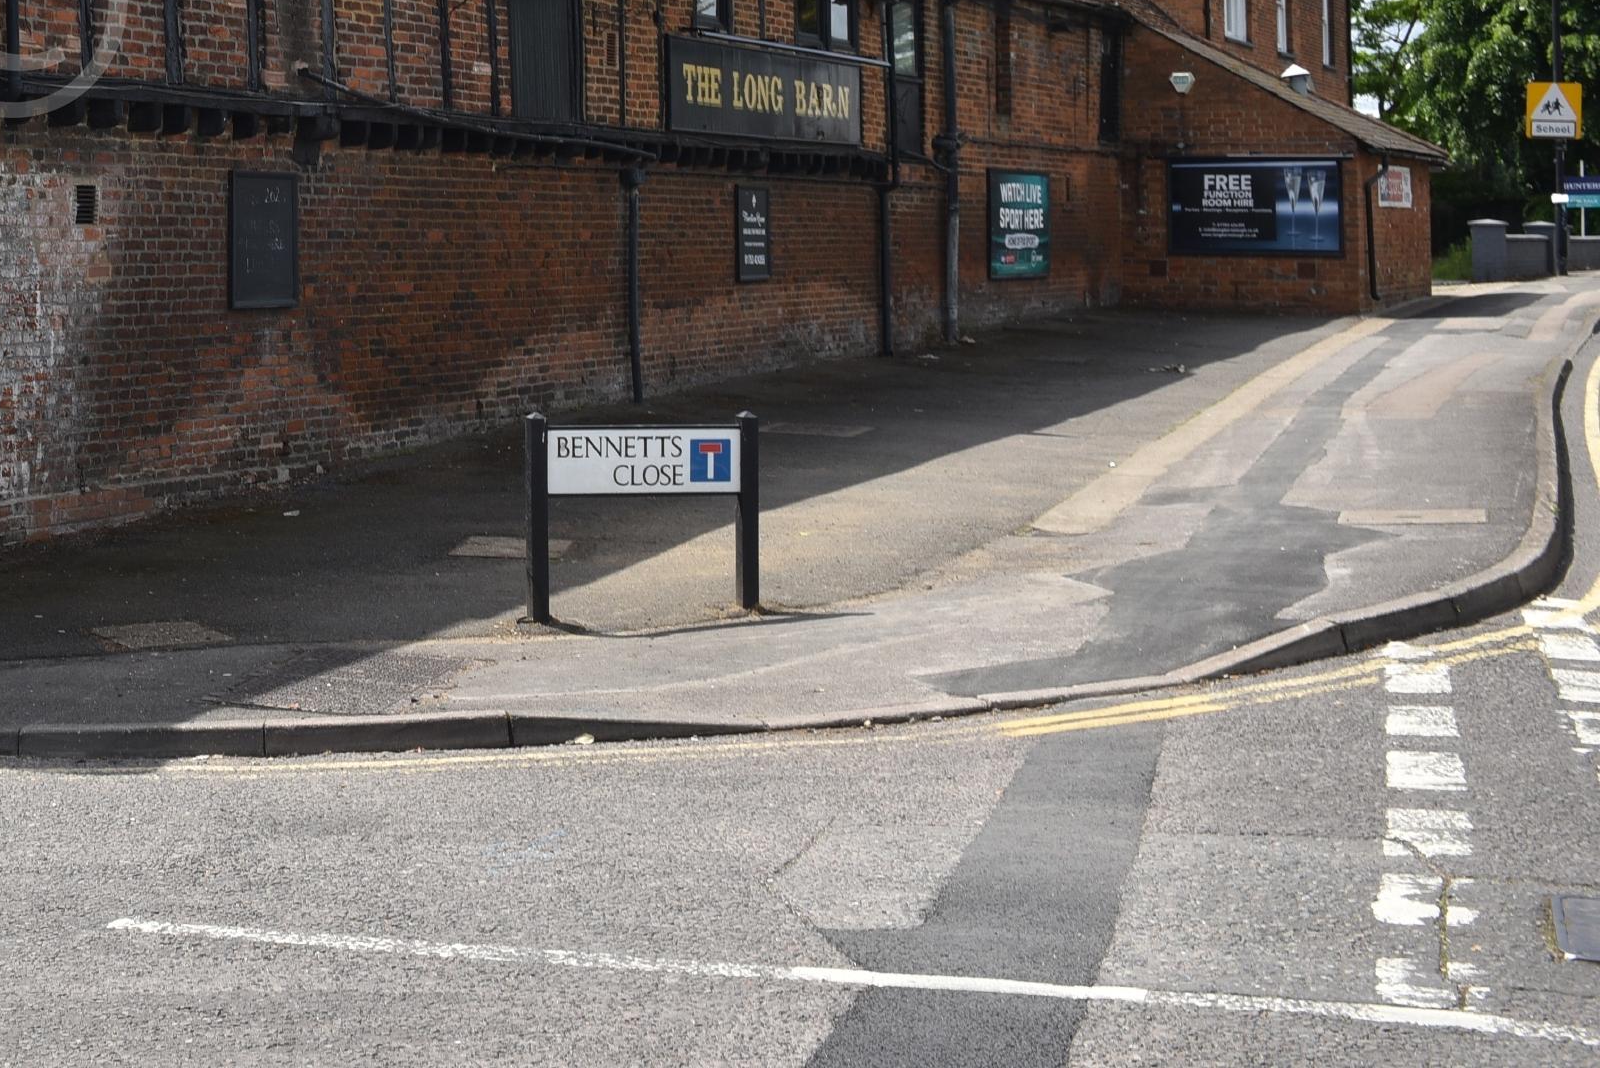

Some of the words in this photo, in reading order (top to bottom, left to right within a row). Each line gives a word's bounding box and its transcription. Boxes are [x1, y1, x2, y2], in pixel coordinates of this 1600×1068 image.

[682, 62, 722, 108] THE
[732, 70, 783, 115] LONG
[794, 79, 850, 119] BARN
[1535, 124, 1570, 134] School
[1000, 182, 1025, 203] WATCH
[1025, 183, 1042, 204] LIVE
[1203, 174, 1252, 191] FREE
[1202, 198, 1232, 208] ROOM
[1233, 198, 1254, 208] HIRE
[1204, 190, 1252, 200] FUNCTION
[999, 207, 1024, 230] SPORT
[1024, 207, 1045, 230] HERE
[557, 435, 683, 459] BENNETTS
[613, 464, 684, 486] CLOSE
